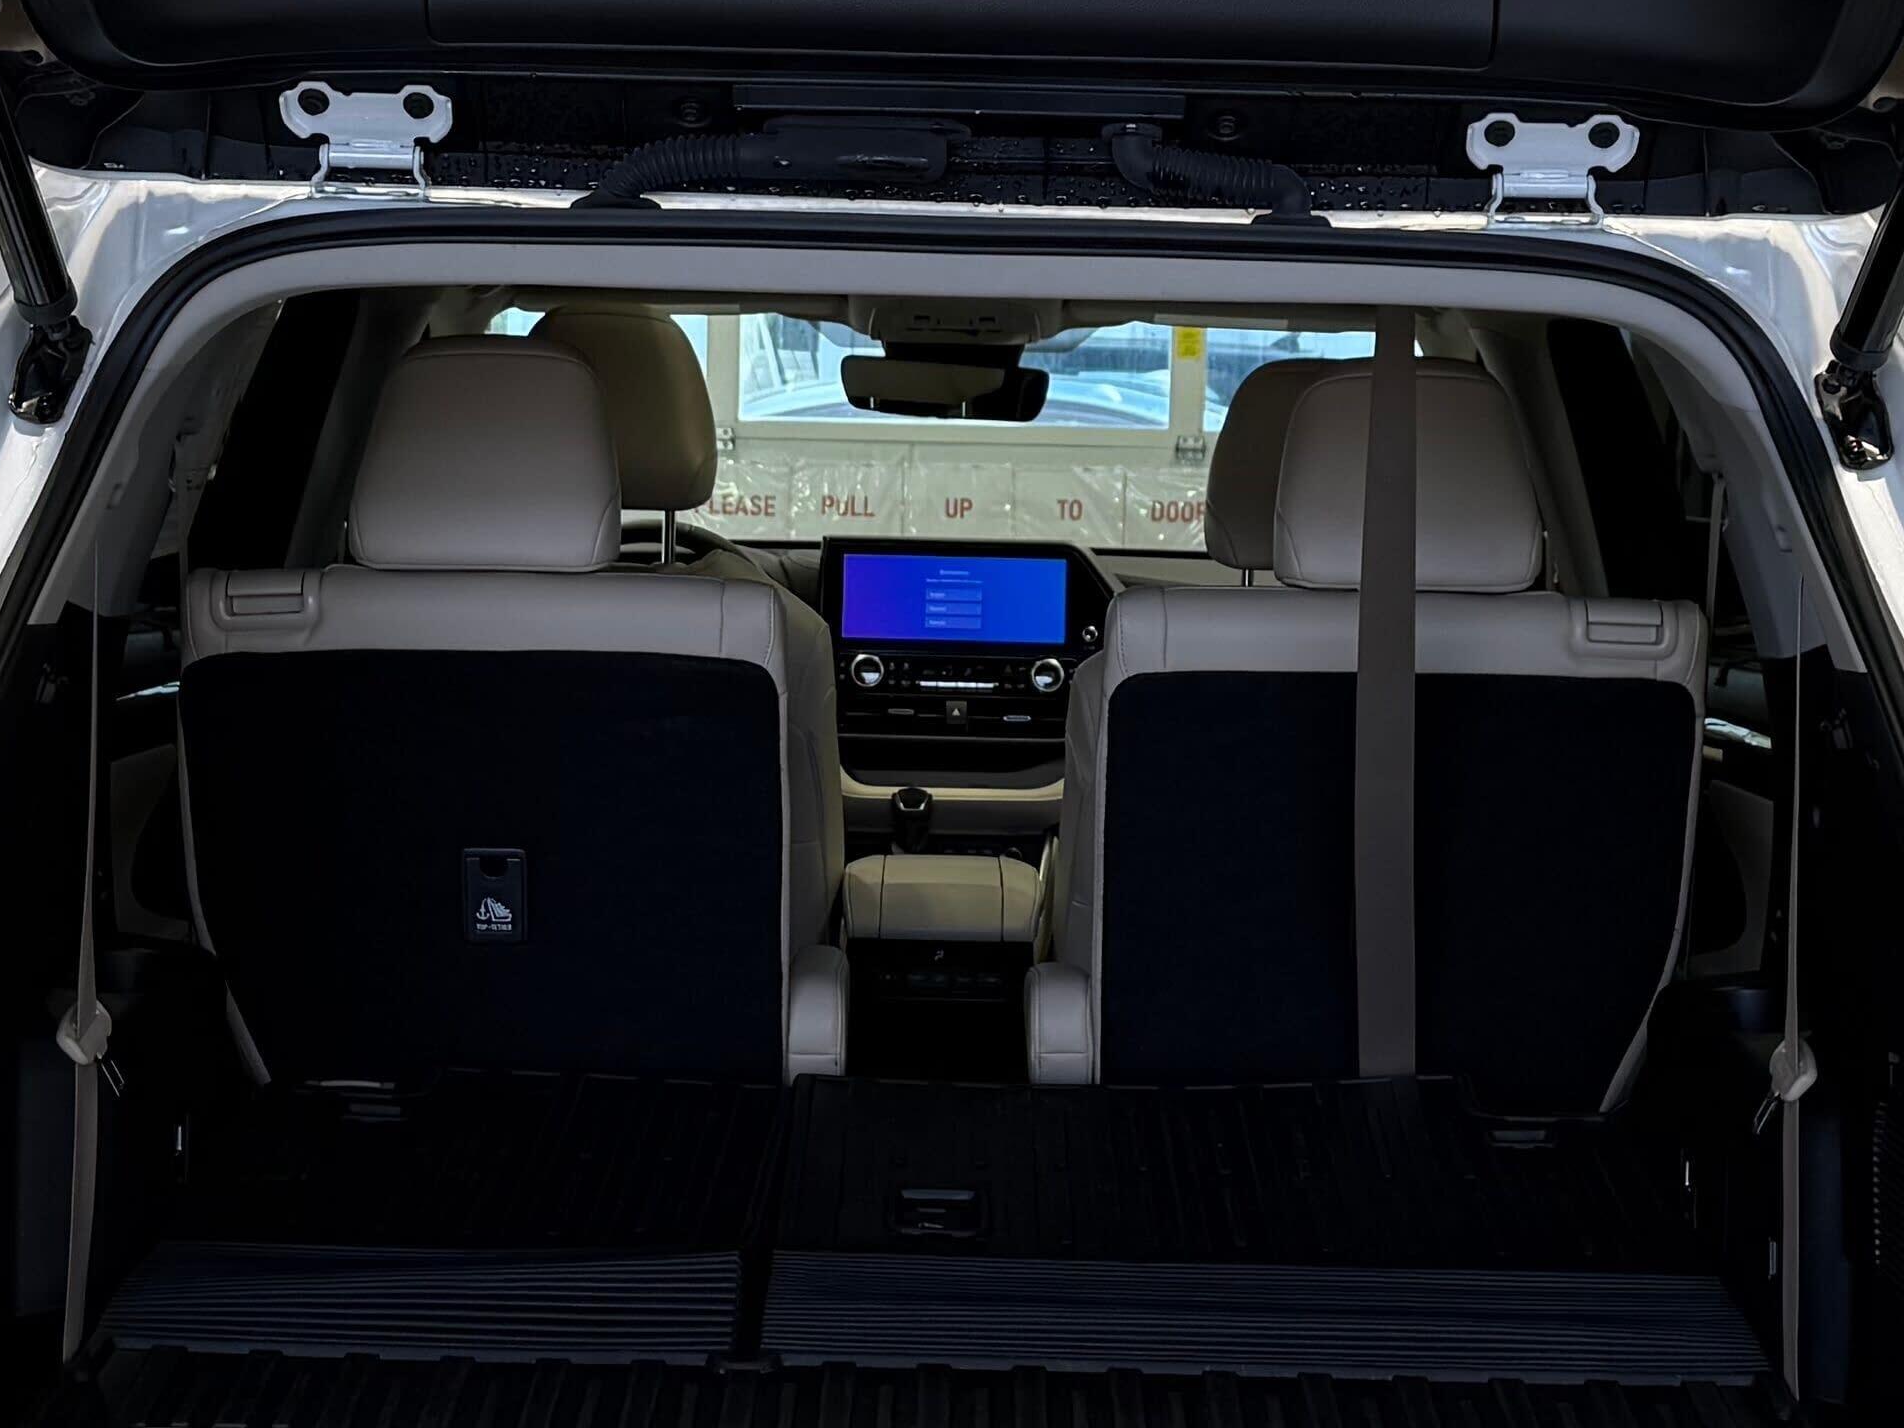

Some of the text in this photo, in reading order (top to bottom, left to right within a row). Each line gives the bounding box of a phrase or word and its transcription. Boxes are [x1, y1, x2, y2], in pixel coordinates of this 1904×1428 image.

[696, 493, 777, 517] LEASE
[821, 495, 875, 518] PULL
[945, 498, 973, 519] UP
[1056, 499, 1084, 521] TO
